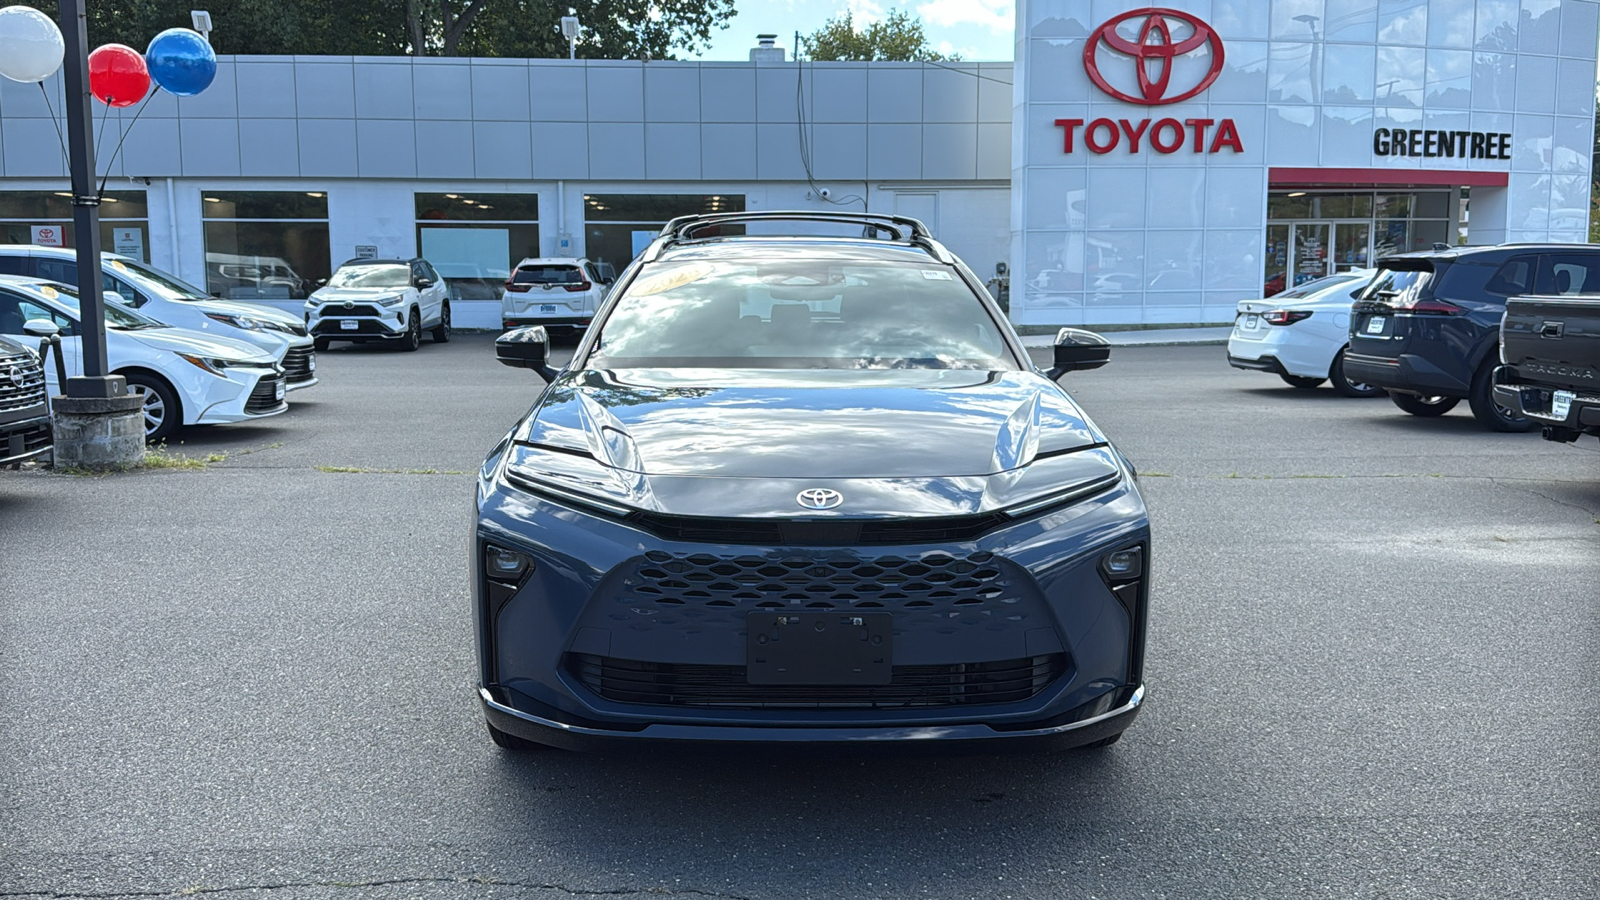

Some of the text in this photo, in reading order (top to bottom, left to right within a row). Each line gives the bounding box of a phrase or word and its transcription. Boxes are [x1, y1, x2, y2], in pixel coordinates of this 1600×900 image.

[1054, 117, 1245, 154] TOYOTA
[1373, 127, 1512, 160] GREENTREE
[1526, 363, 1594, 379] TACOMA
